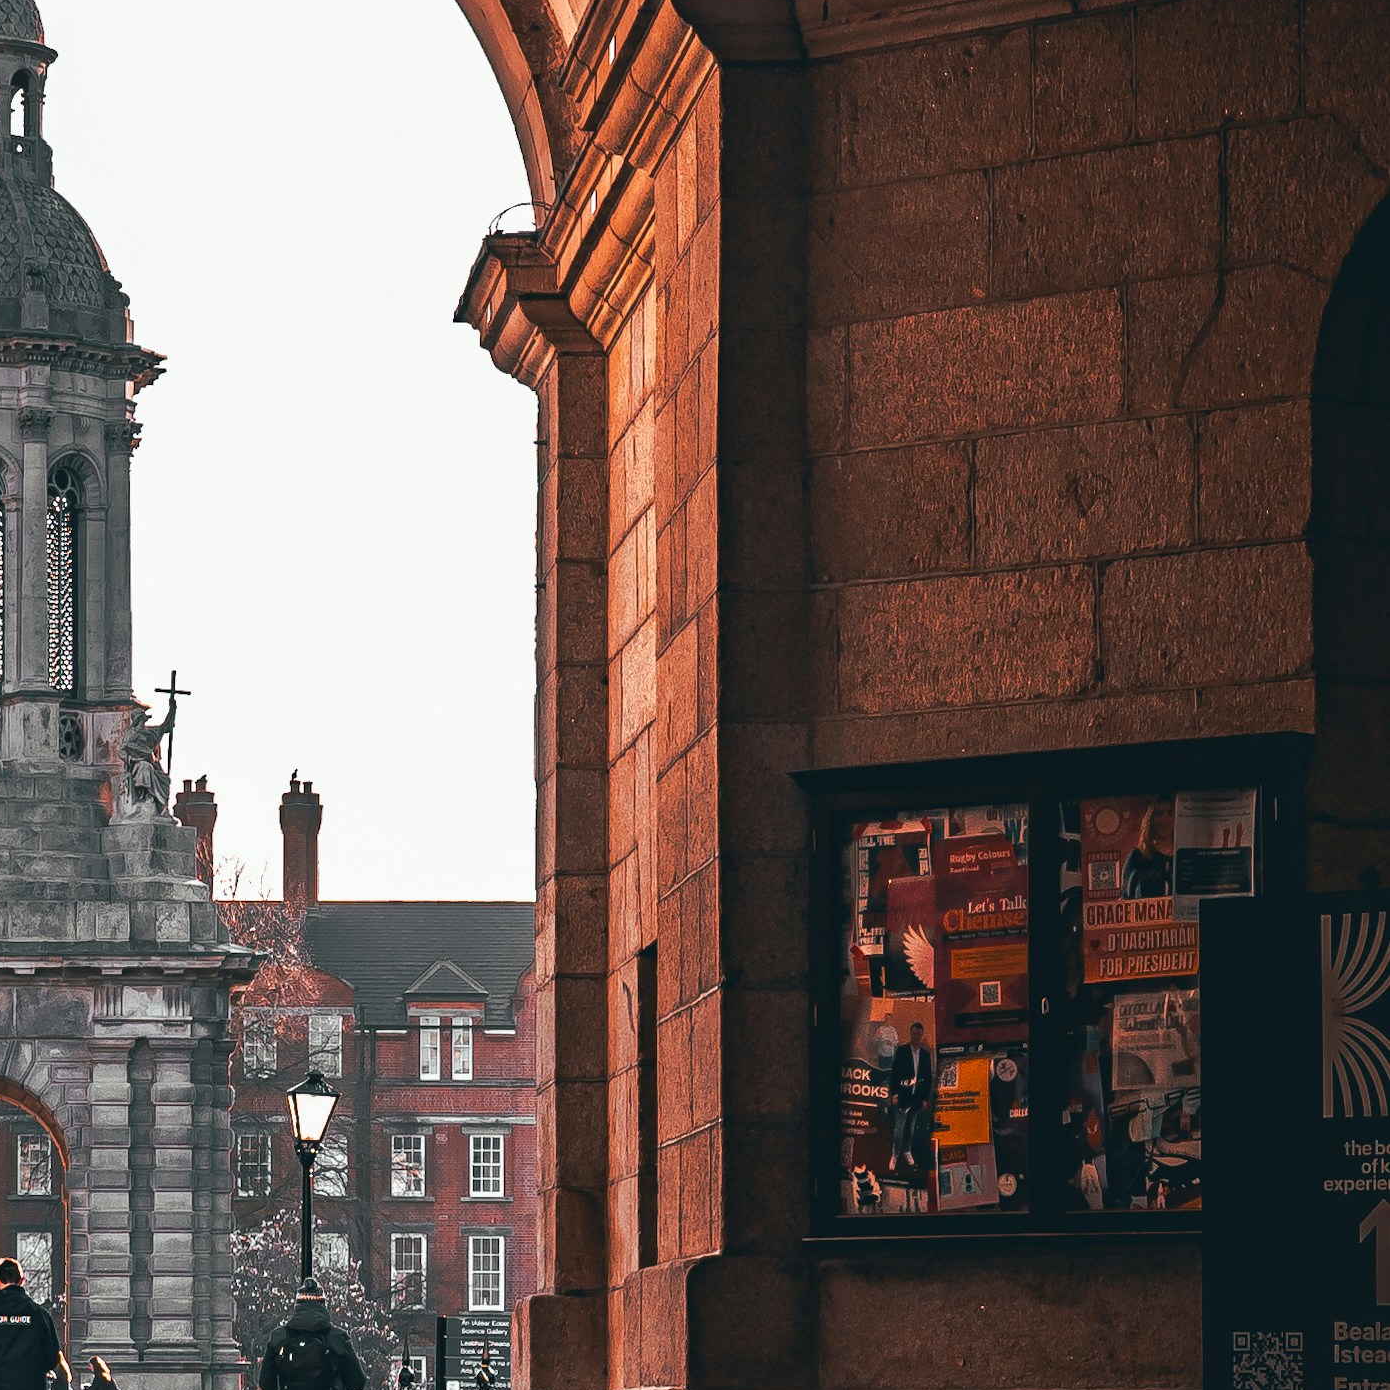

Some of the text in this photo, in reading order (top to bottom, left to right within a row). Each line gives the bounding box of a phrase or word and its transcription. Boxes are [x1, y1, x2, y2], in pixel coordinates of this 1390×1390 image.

[877, 835, 896, 846] THE
[949, 850, 1011, 865] Rugby Colours
[968, 898, 994, 915] Let's
[1086, 903, 1131, 926] GRACE
[1108, 924, 1195, 952] D'UACHTARÁN
[1100, 951, 1196, 976] FOR PRESIDENT
[1344, 1140, 1372, 1156] the
[1361, 1158, 1378, 1174] of
[1324, 1176, 1390, 1195] experie
[10, 1316, 30, 1324] GUIDE
[486, 1328, 508, 1336] Gallery
[1334, 1344, 1390, 1364] Istea
